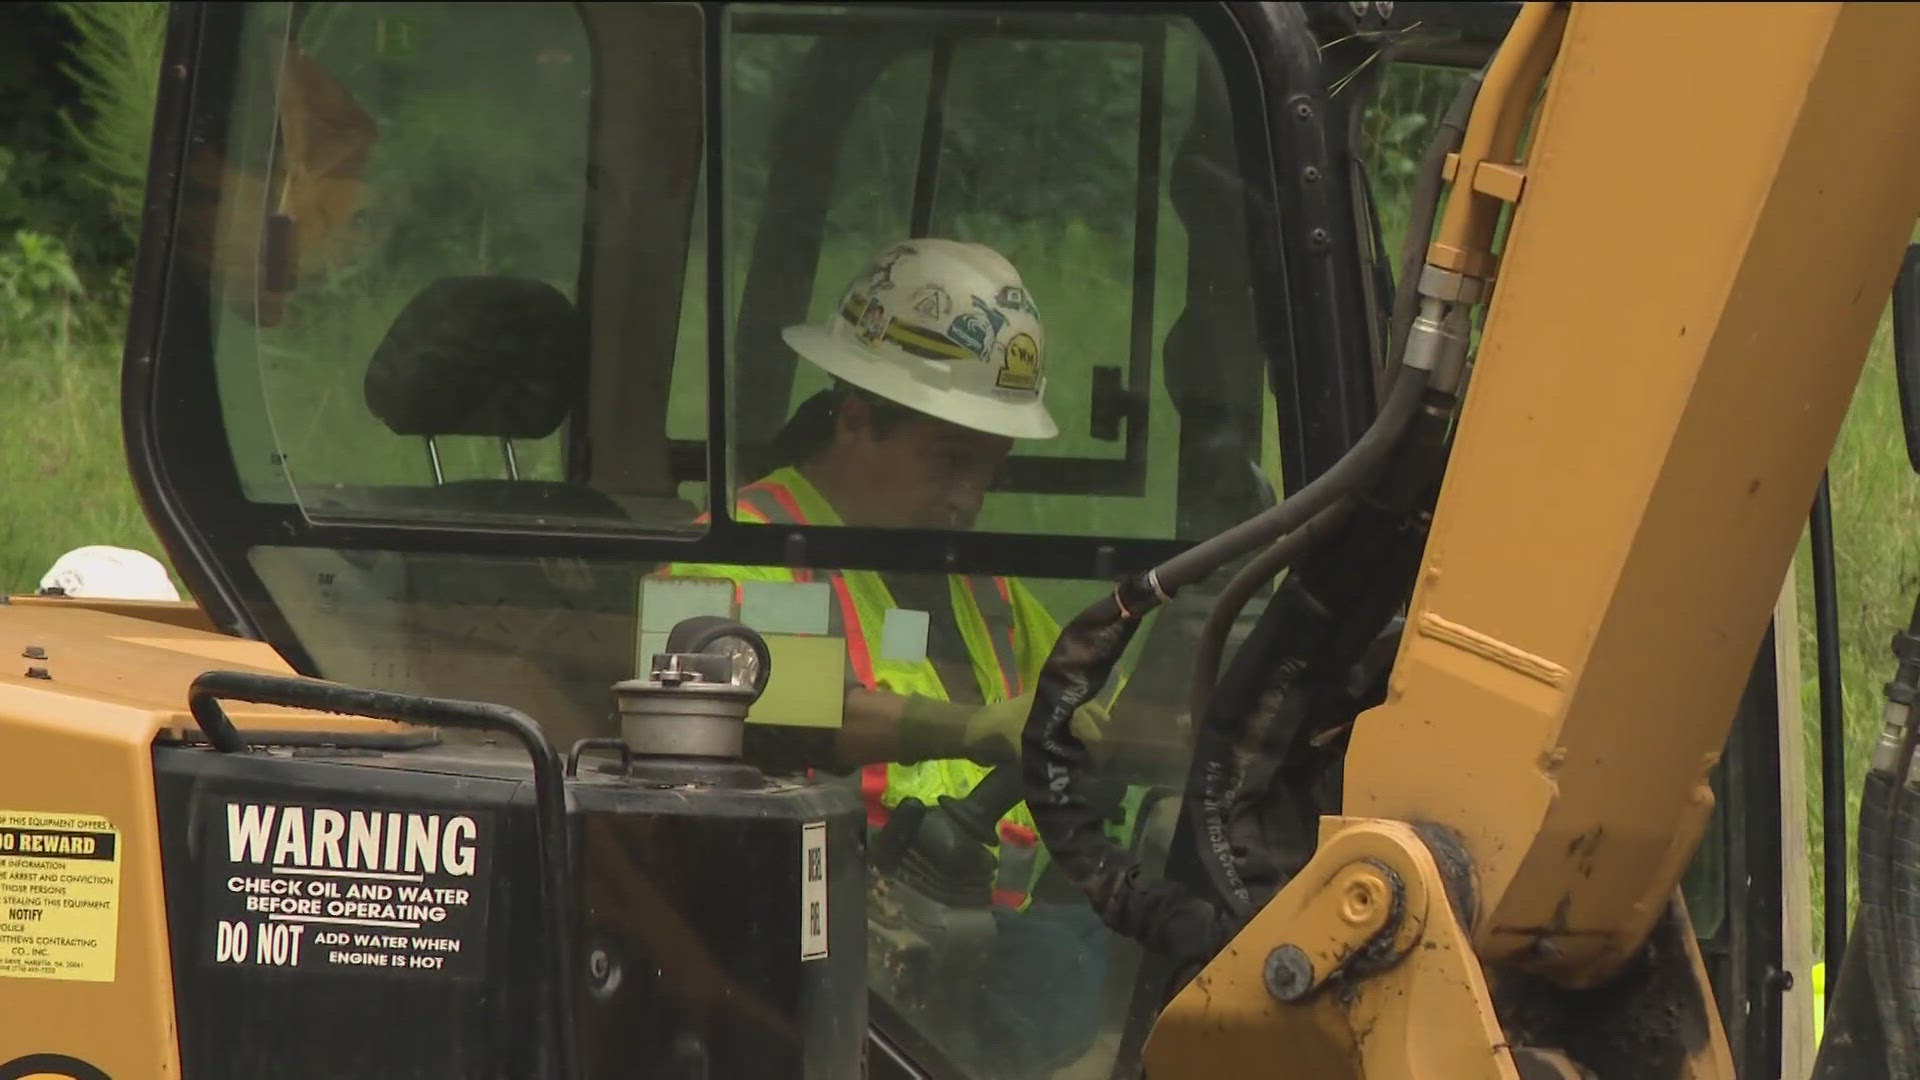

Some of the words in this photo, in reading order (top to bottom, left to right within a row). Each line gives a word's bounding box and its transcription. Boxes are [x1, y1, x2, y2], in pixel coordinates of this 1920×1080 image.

[9, 817, 27, 826] THIS
[29, 817, 75, 829] EQUIPMENT
[77, 820, 107, 830] OFFERS
[20, 833, 96, 855] REWARD
[226, 802, 478, 877] WARNING
[8, 859, 66, 870] INFORMATION
[9, 872, 38, 881] ARREST
[40, 873, 59, 883] AND
[60, 874, 114, 885] CONVICTION
[2, 883, 27, 893] THOSE
[30, 884, 67, 896] PERSONS
[227, 876, 303, 897] CHECK
[307, 880, 342, 899] OIL
[345, 883, 393, 901] AND
[398, 886, 470, 906] WATER
[3, 896, 41, 907] STEALING
[44, 898, 61, 908] THIS
[63, 899, 111, 910] EQUIPMENT
[246, 895, 322, 915] BEFORE
[326, 900, 447, 922] OPERATING
[9, 908, 43, 921] NOTIFY
[36, 936, 98, 948] CONTRACTING
[216, 920, 249, 964] DO
[256, 922, 305, 967] NOT
[314, 931, 350, 946] ADD
[354, 934, 409, 949] WATER
[411, 936, 461, 953] WHEN
[328, 951, 389, 967] ENGINE
[391, 955, 407, 967] IS
[409, 955, 445, 970] HOT
